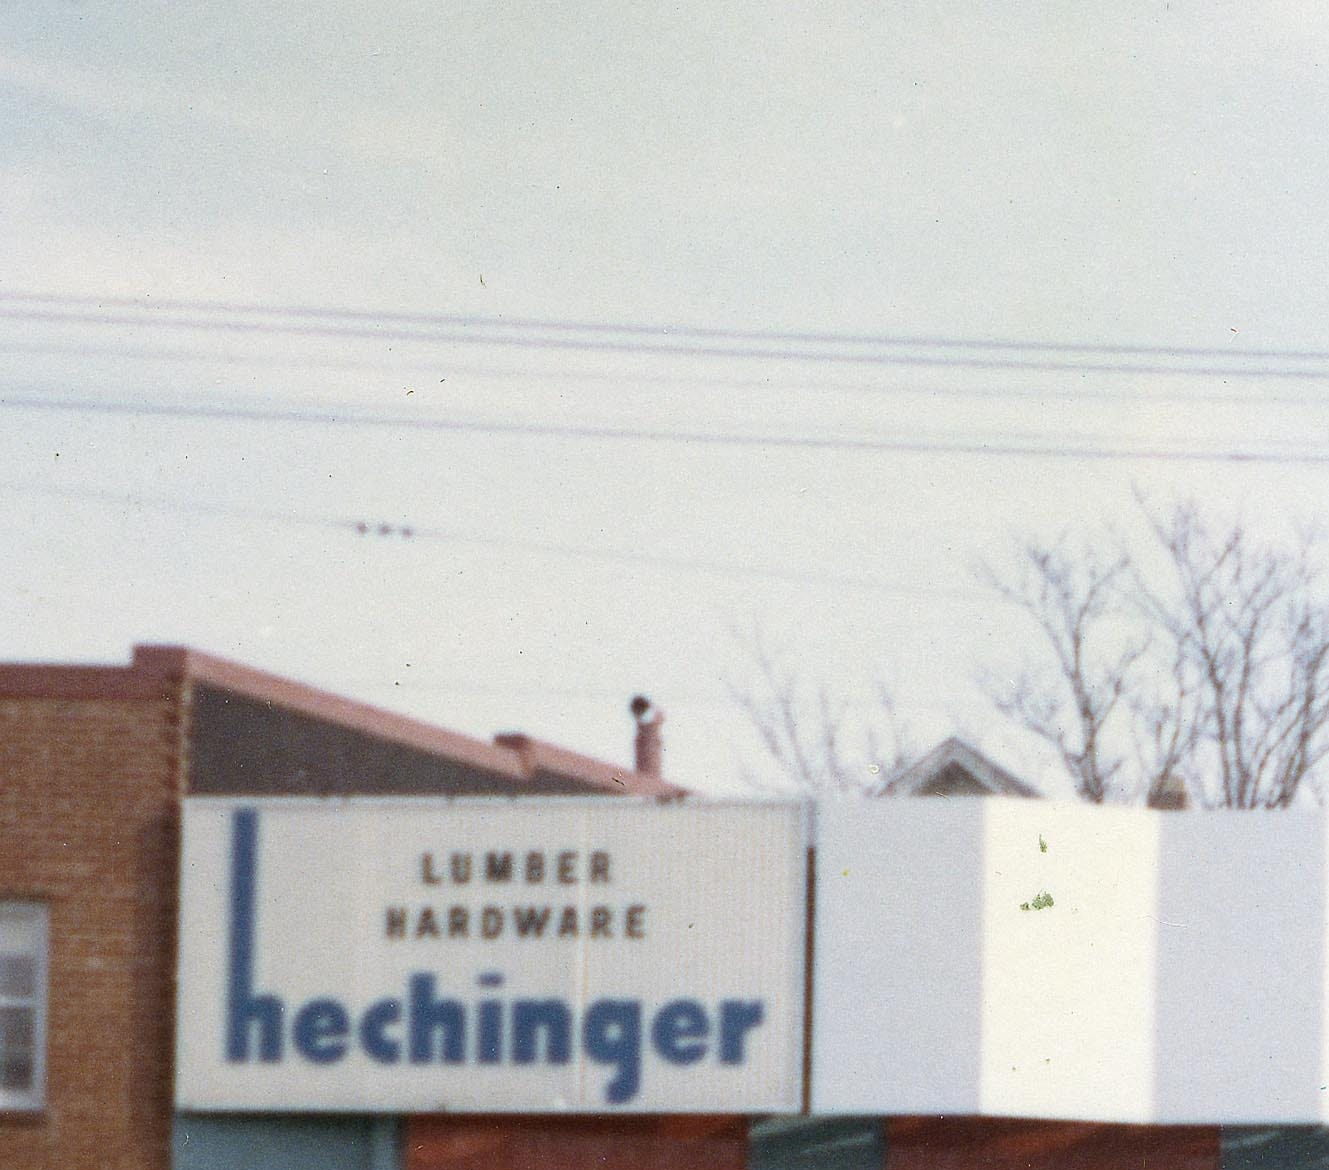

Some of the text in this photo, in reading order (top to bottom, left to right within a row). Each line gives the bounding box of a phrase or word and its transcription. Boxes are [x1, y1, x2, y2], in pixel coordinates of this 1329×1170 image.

[421, 851, 613, 886] LUMBER
[385, 904, 648, 941] HARDWARE
[226, 807, 765, 1103] hechinger
